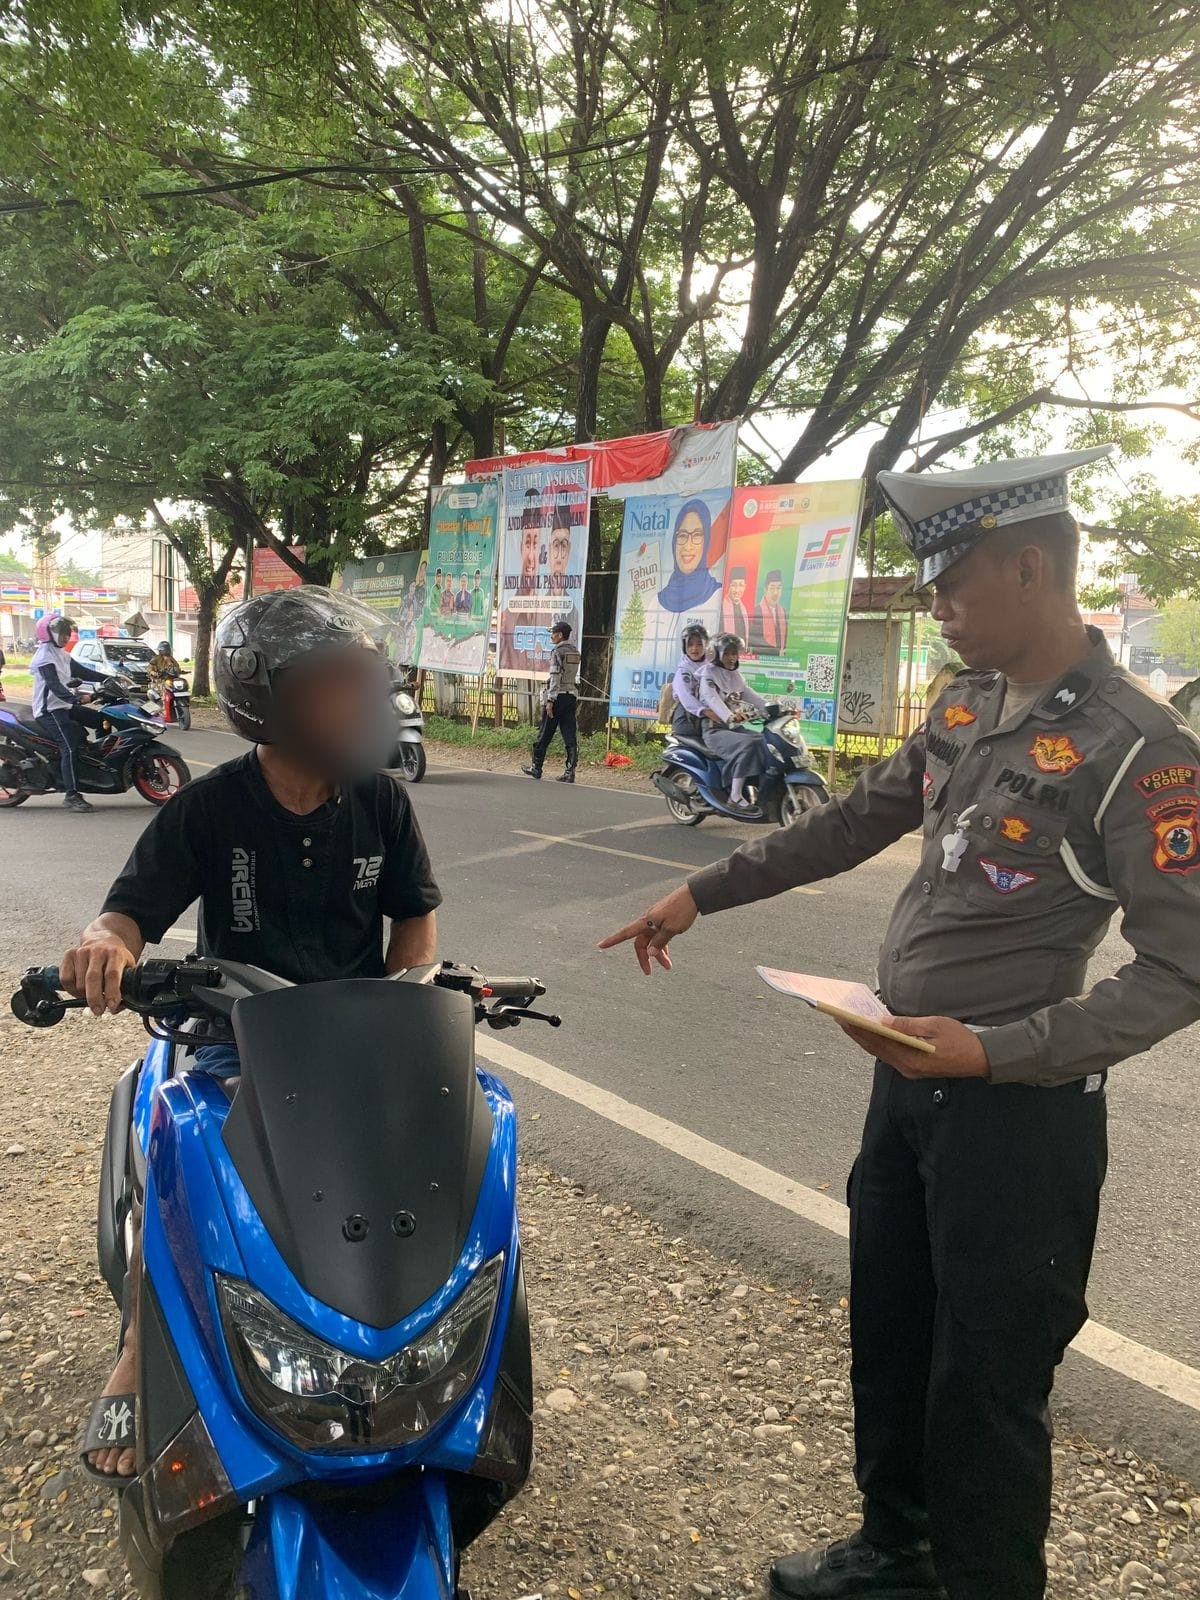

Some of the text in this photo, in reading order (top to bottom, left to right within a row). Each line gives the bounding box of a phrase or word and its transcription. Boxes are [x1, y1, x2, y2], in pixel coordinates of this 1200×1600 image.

[553, 468, 586, 487] SUKSES
[630, 508, 671, 532] Natal
[539, 543, 548, 565] &
[628, 562, 658, 580] Tahun
[632, 576, 657, 591] Baru
[1143, 768, 1192, 788] POLRES
[1153, 776, 1187, 789] BONE
[994, 768, 1070, 812] POLRI
[353, 855, 383, 879] 72
[231, 847, 253, 933] ARENA
